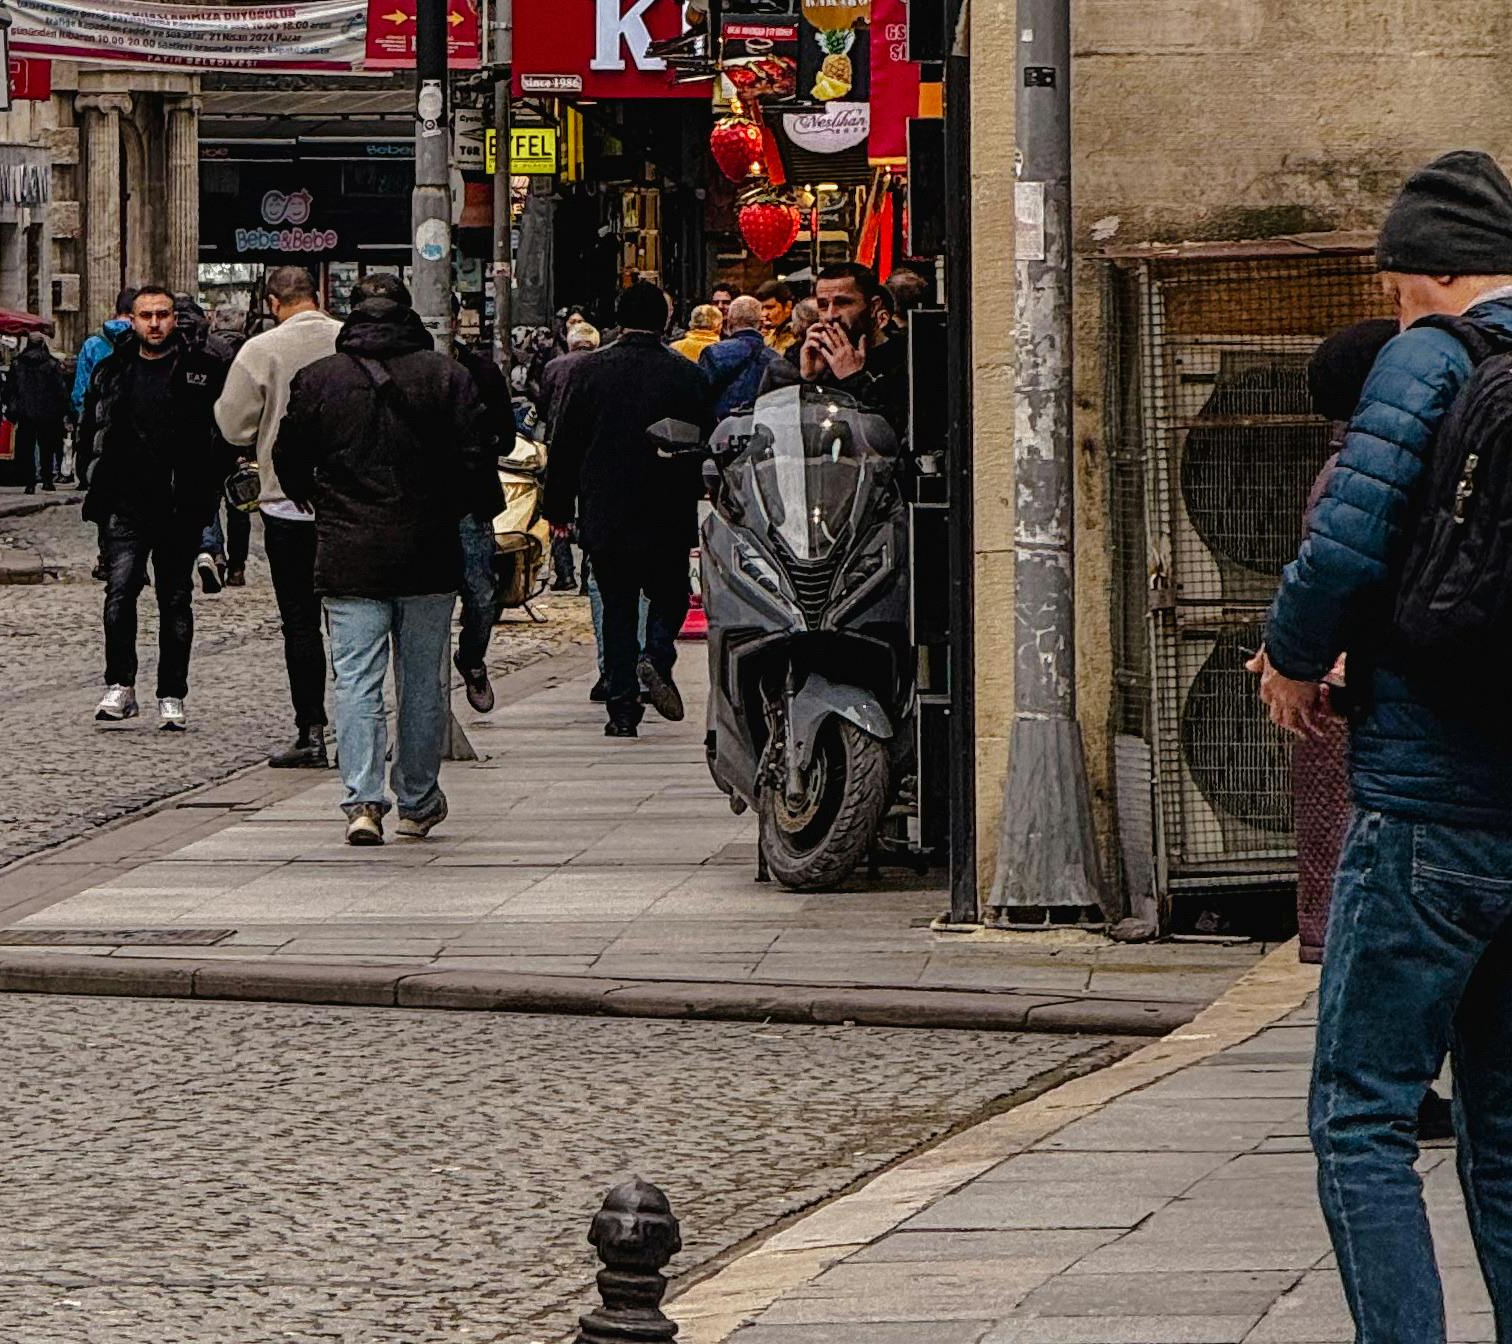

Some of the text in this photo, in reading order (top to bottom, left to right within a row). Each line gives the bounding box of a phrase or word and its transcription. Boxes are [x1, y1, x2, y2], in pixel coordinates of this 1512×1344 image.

[249, 33, 274, 42] 2024
[523, 77, 580, 89] since 1986
[235, 226, 338, 252] Bebe&Bebe
